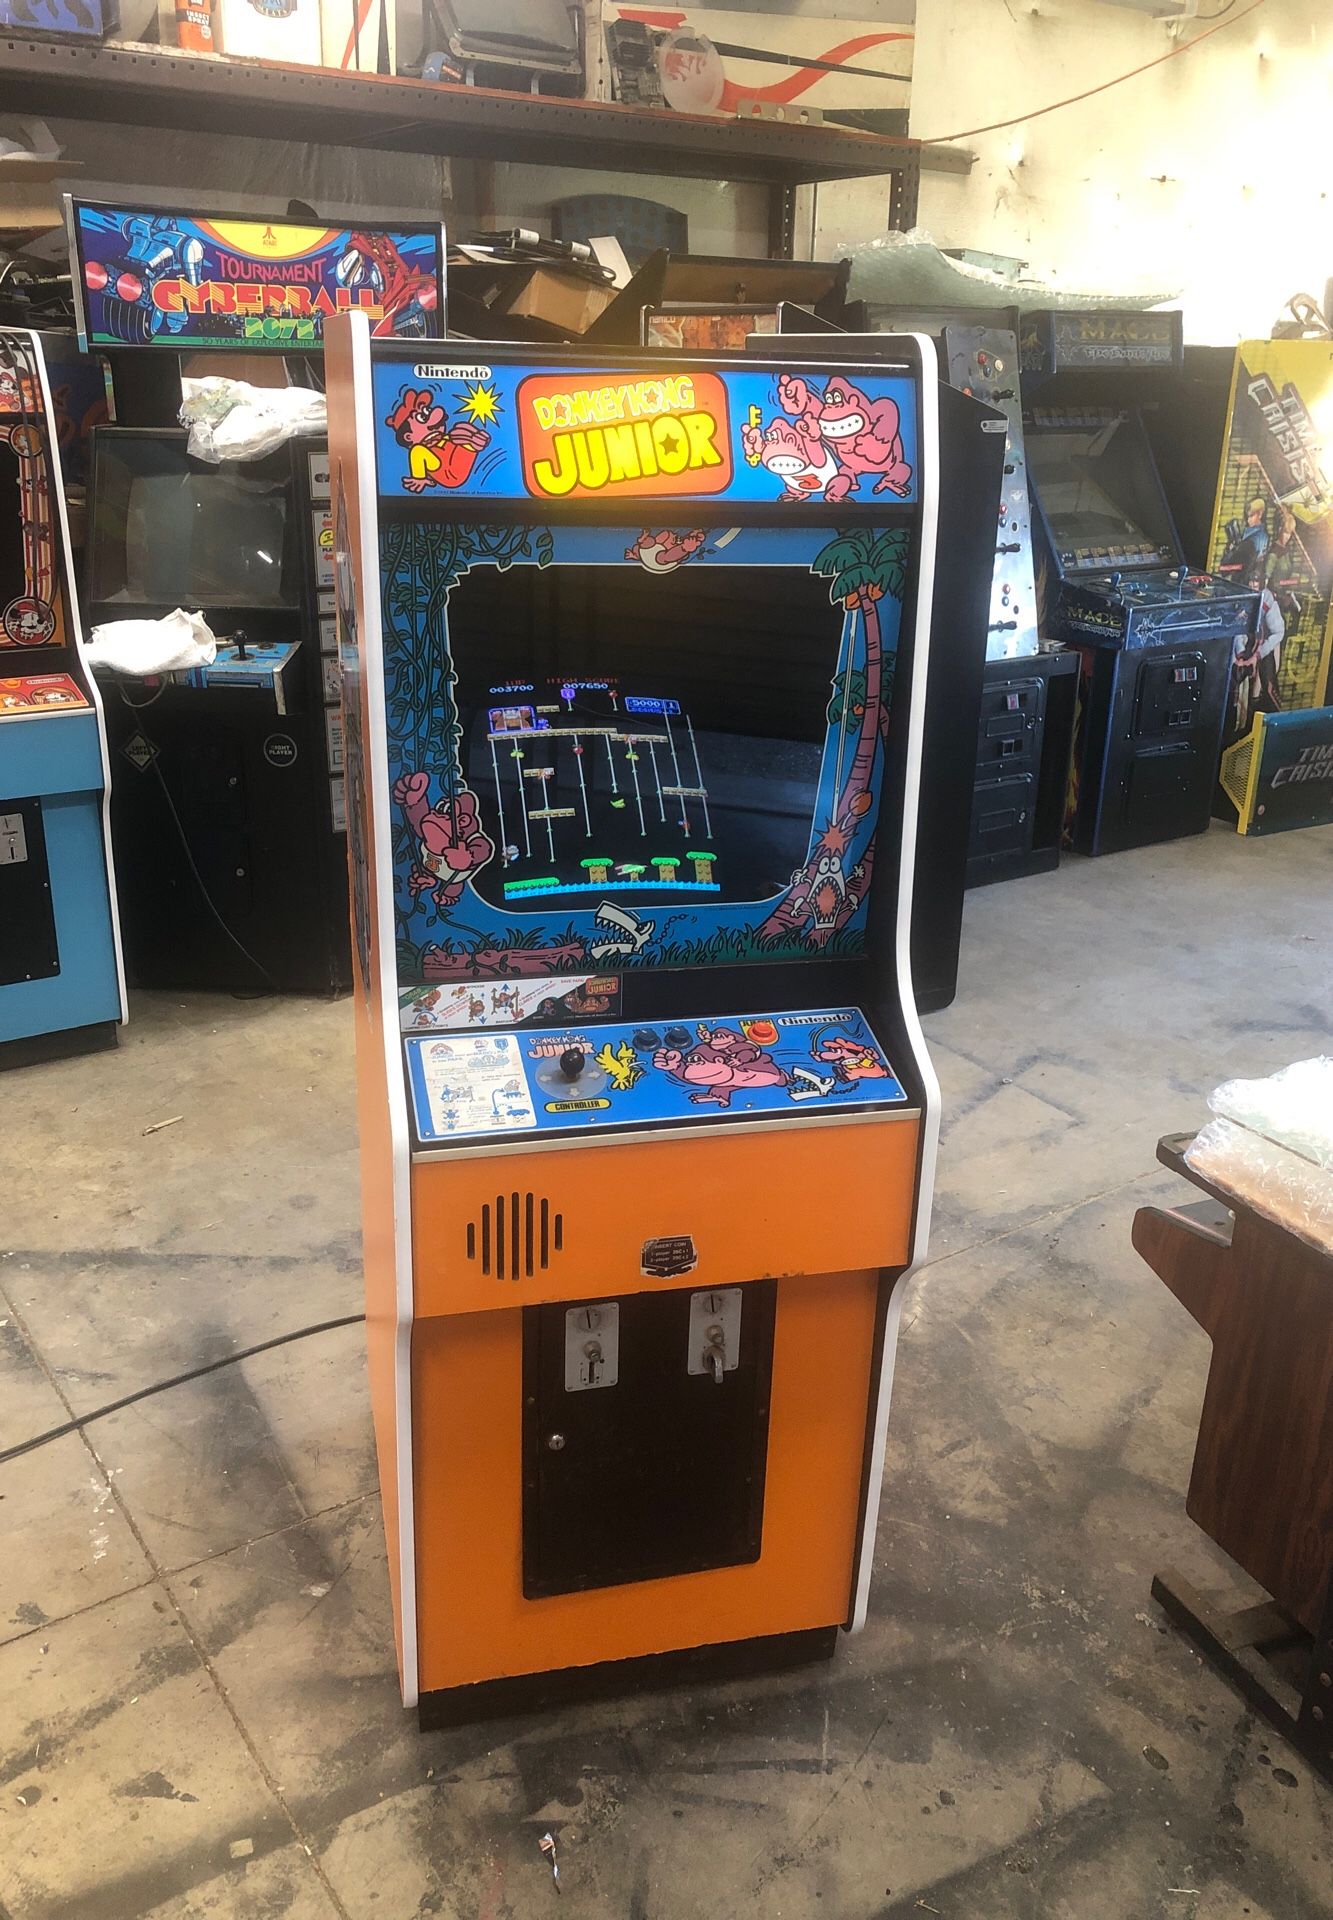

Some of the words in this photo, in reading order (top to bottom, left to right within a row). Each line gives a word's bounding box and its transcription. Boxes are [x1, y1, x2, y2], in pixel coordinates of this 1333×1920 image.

[263, 239, 277, 247] ATARI
[215, 250, 328, 283] TOURNAMENT
[151, 277, 385, 320] CYBERBALL
[244, 316, 315, 340] 2072
[214, 337, 239, 347] YEARS
[240, 338, 249, 347] OF
[252, 338, 289, 347] EXPLOSIVE
[418, 365, 490, 379] Nintendo
[532, 384, 627, 431] DONKEY
[626, 375, 696, 420] KONG
[533, 411, 725, 496] JUNIOR
[489, 684, 534, 694] 003700
[562, 682, 609, 690] 007650
[587, 983, 616, 995] JUNIOR
[781, 1013, 851, 1026] Nintendo
[528, 1036, 562, 1045] DONKEY
[562, 1034, 587, 1044] KONG
[554, 1100, 601, 1111] CONTROLLER
